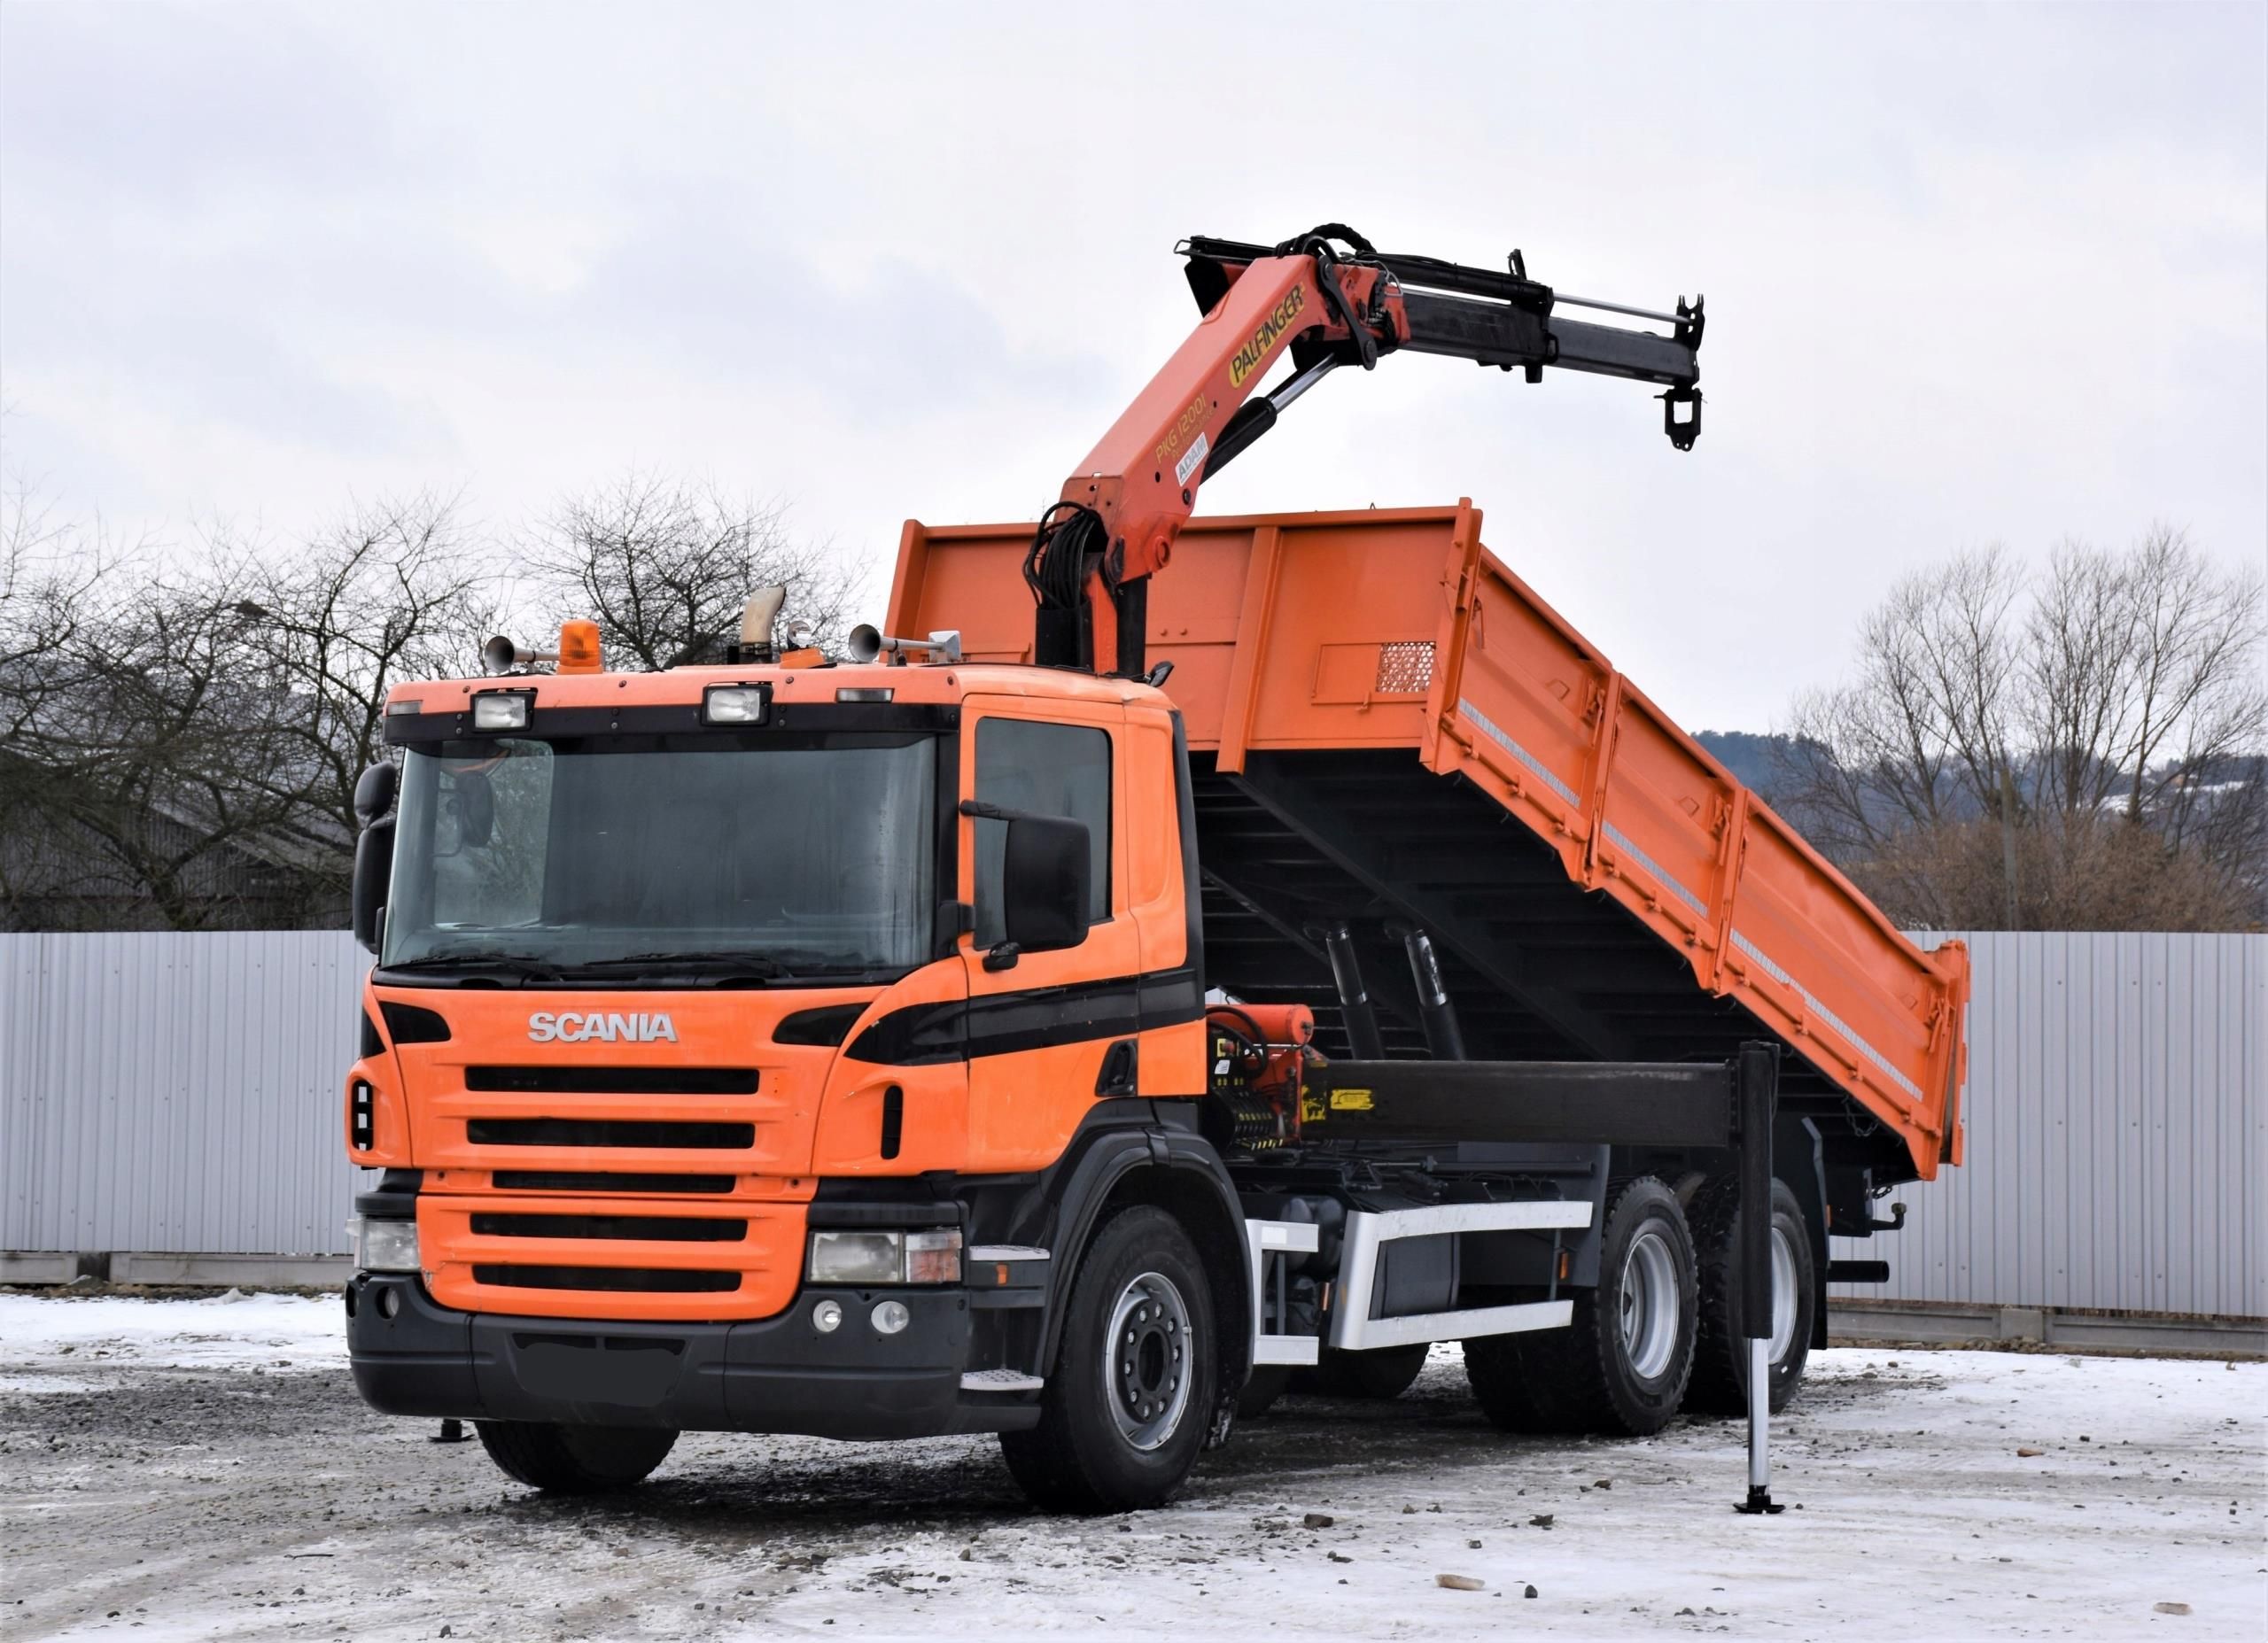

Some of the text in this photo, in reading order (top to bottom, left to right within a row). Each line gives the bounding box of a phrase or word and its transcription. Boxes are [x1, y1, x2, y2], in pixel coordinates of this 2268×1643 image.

[1231, 284, 1303, 384] PALFINGER
[1155, 429, 1177, 464] PKG
[1178, 435, 1207, 480] ADAM
[528, 1012, 678, 1042] SCANIA
